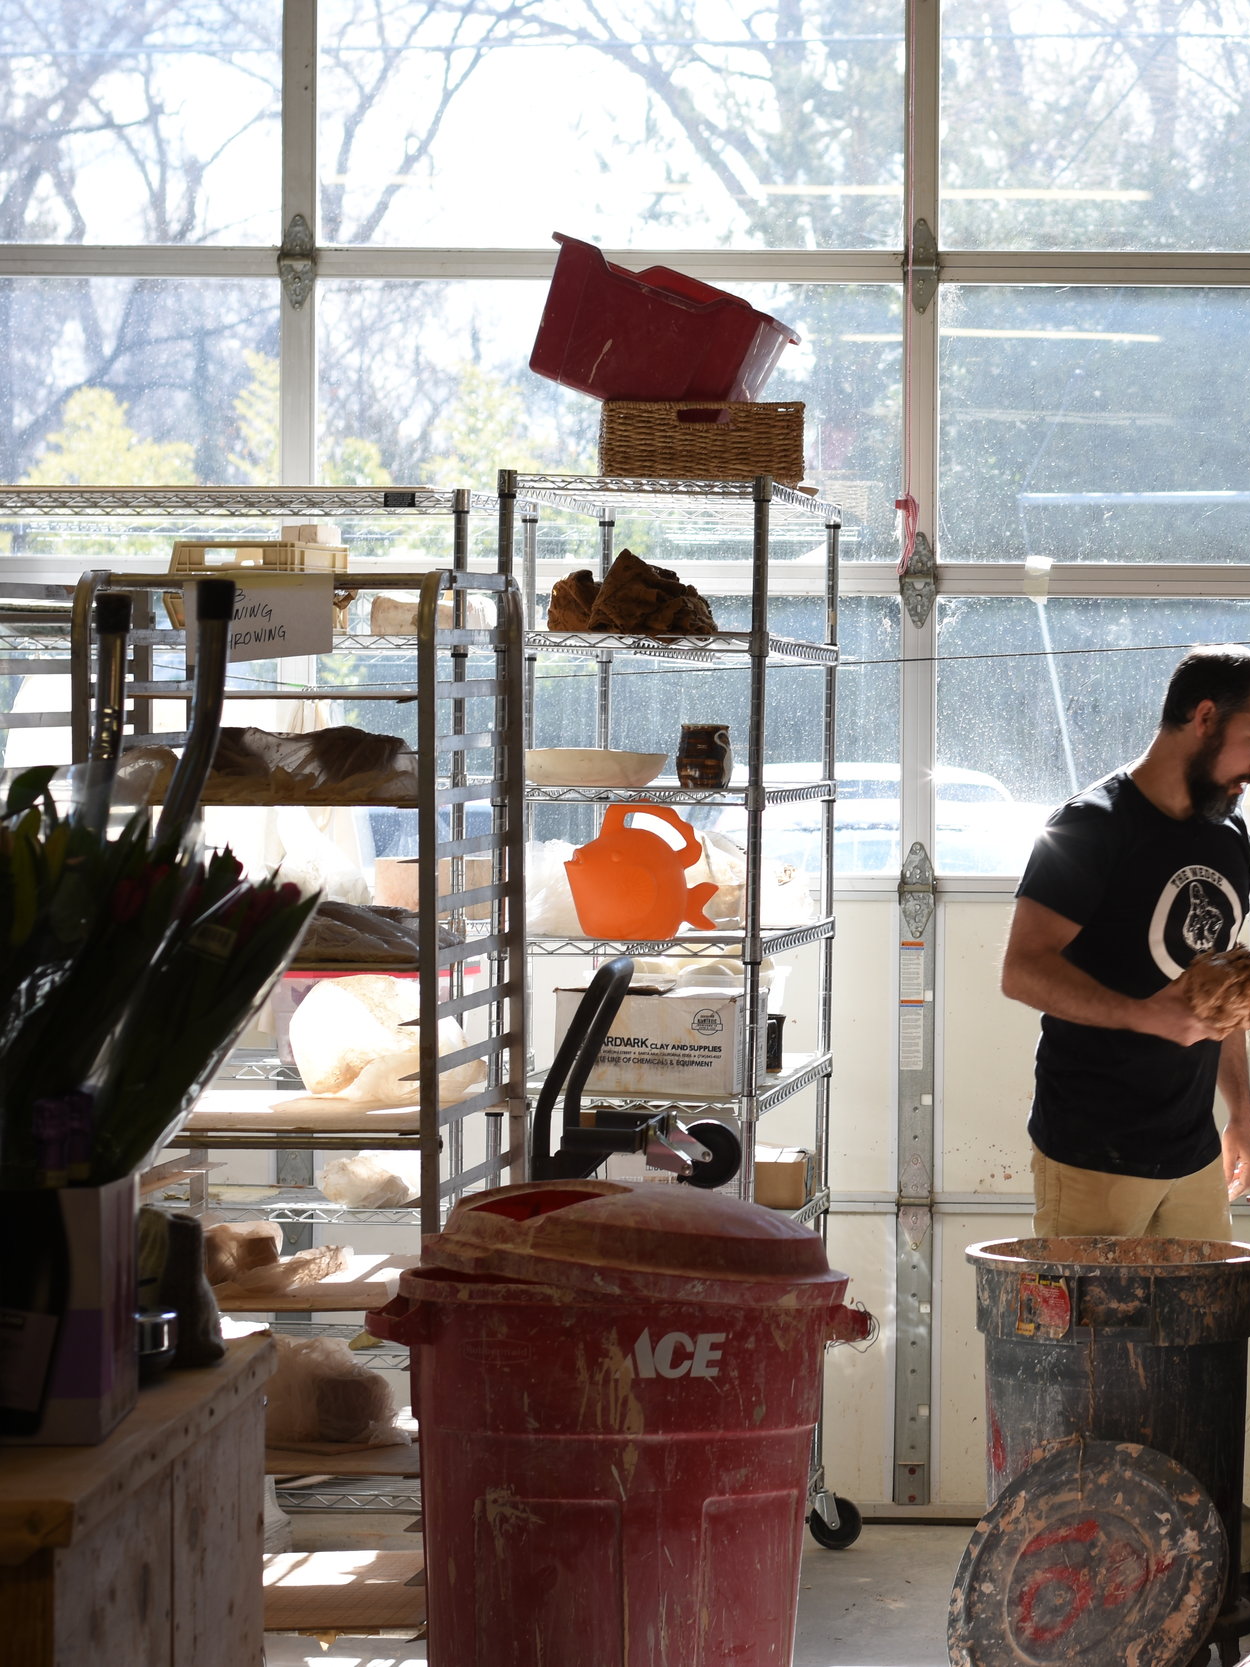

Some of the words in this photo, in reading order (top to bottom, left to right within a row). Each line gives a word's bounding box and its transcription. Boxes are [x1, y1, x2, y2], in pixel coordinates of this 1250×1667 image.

[233, 603, 273, 622] NING
[1170, 869, 1190, 889] THE
[1189, 866, 1224, 887] WEDGE
[689, 1045, 722, 1053] SUPPLIES
[622, 1056, 632, 1064] OF
[632, 1057, 668, 1066] CHEMICALS
[676, 1059, 713, 1068] EQUIPMENT
[613, 1326, 726, 1379] ACE
